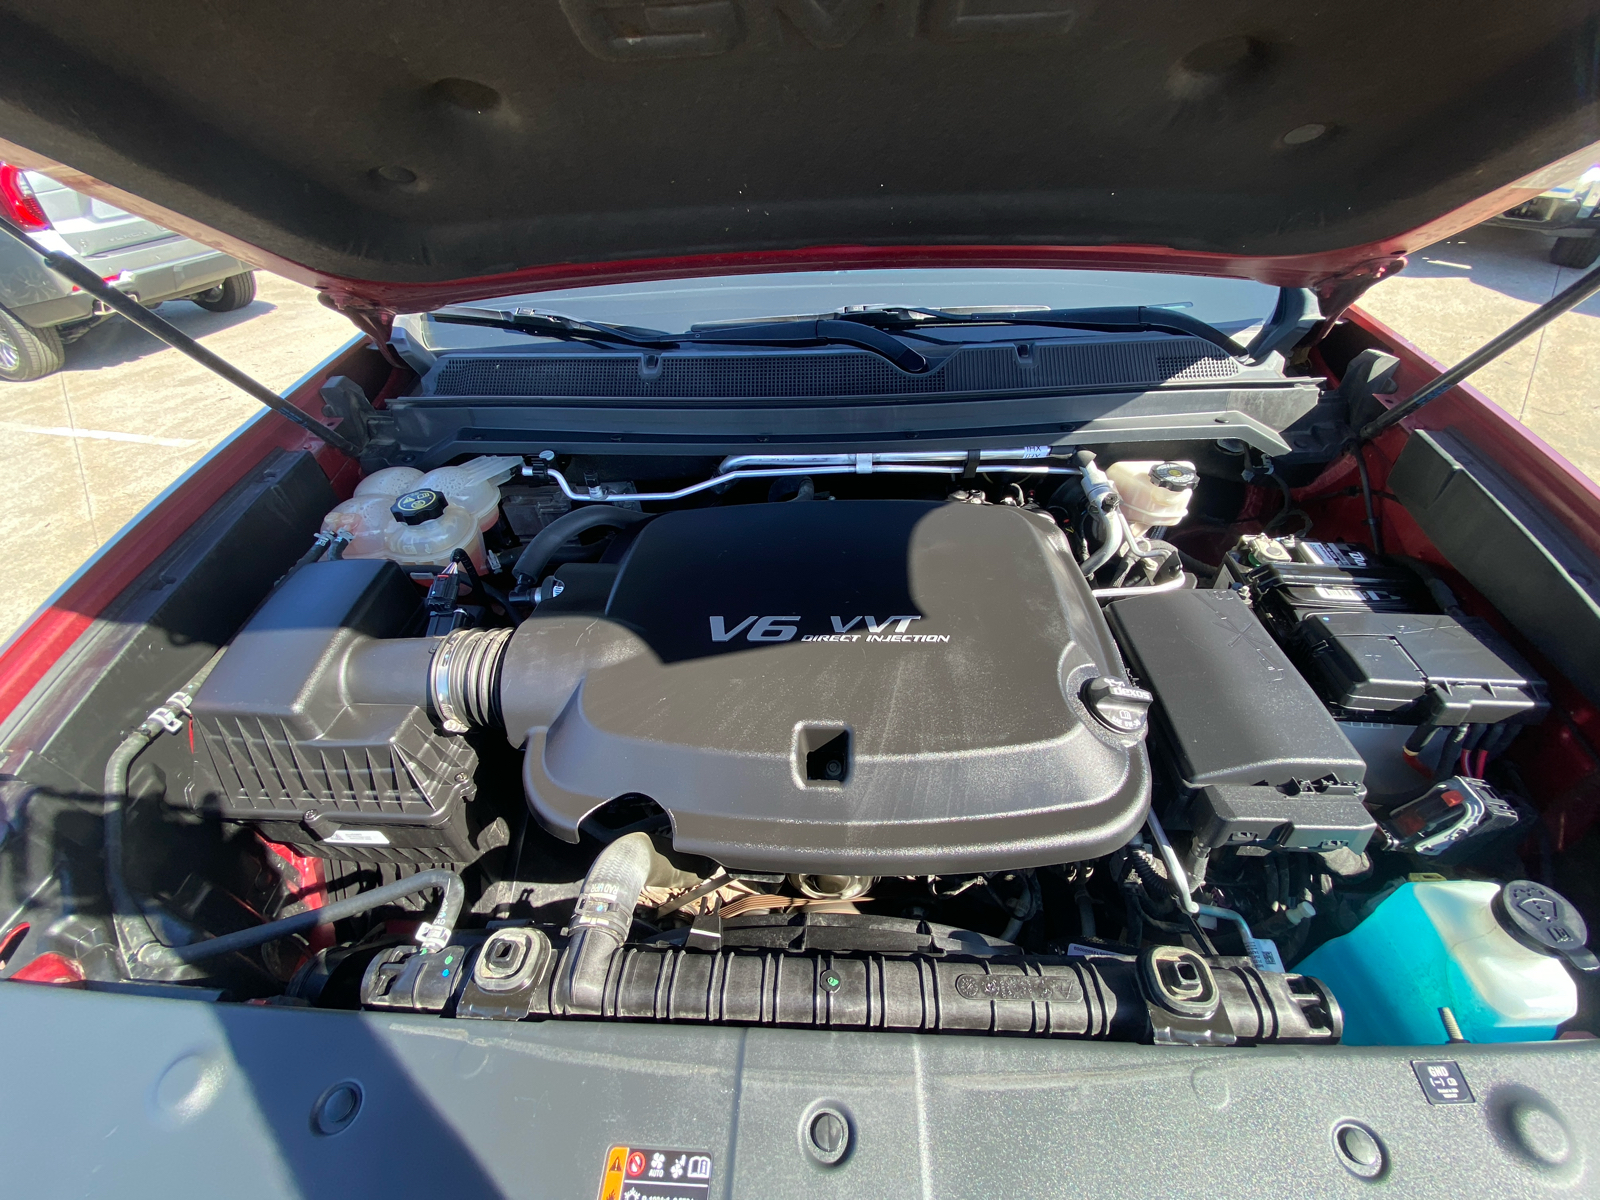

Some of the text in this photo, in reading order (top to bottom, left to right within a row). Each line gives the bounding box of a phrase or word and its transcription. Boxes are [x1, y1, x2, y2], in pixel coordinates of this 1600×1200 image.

[709, 615, 921, 642] V6 VVT
[801, 634, 951, 643] DIRECT INJECTION
[1113, 686, 1151, 700] dexos
[648, 1168, 664, 1178] AUTO
